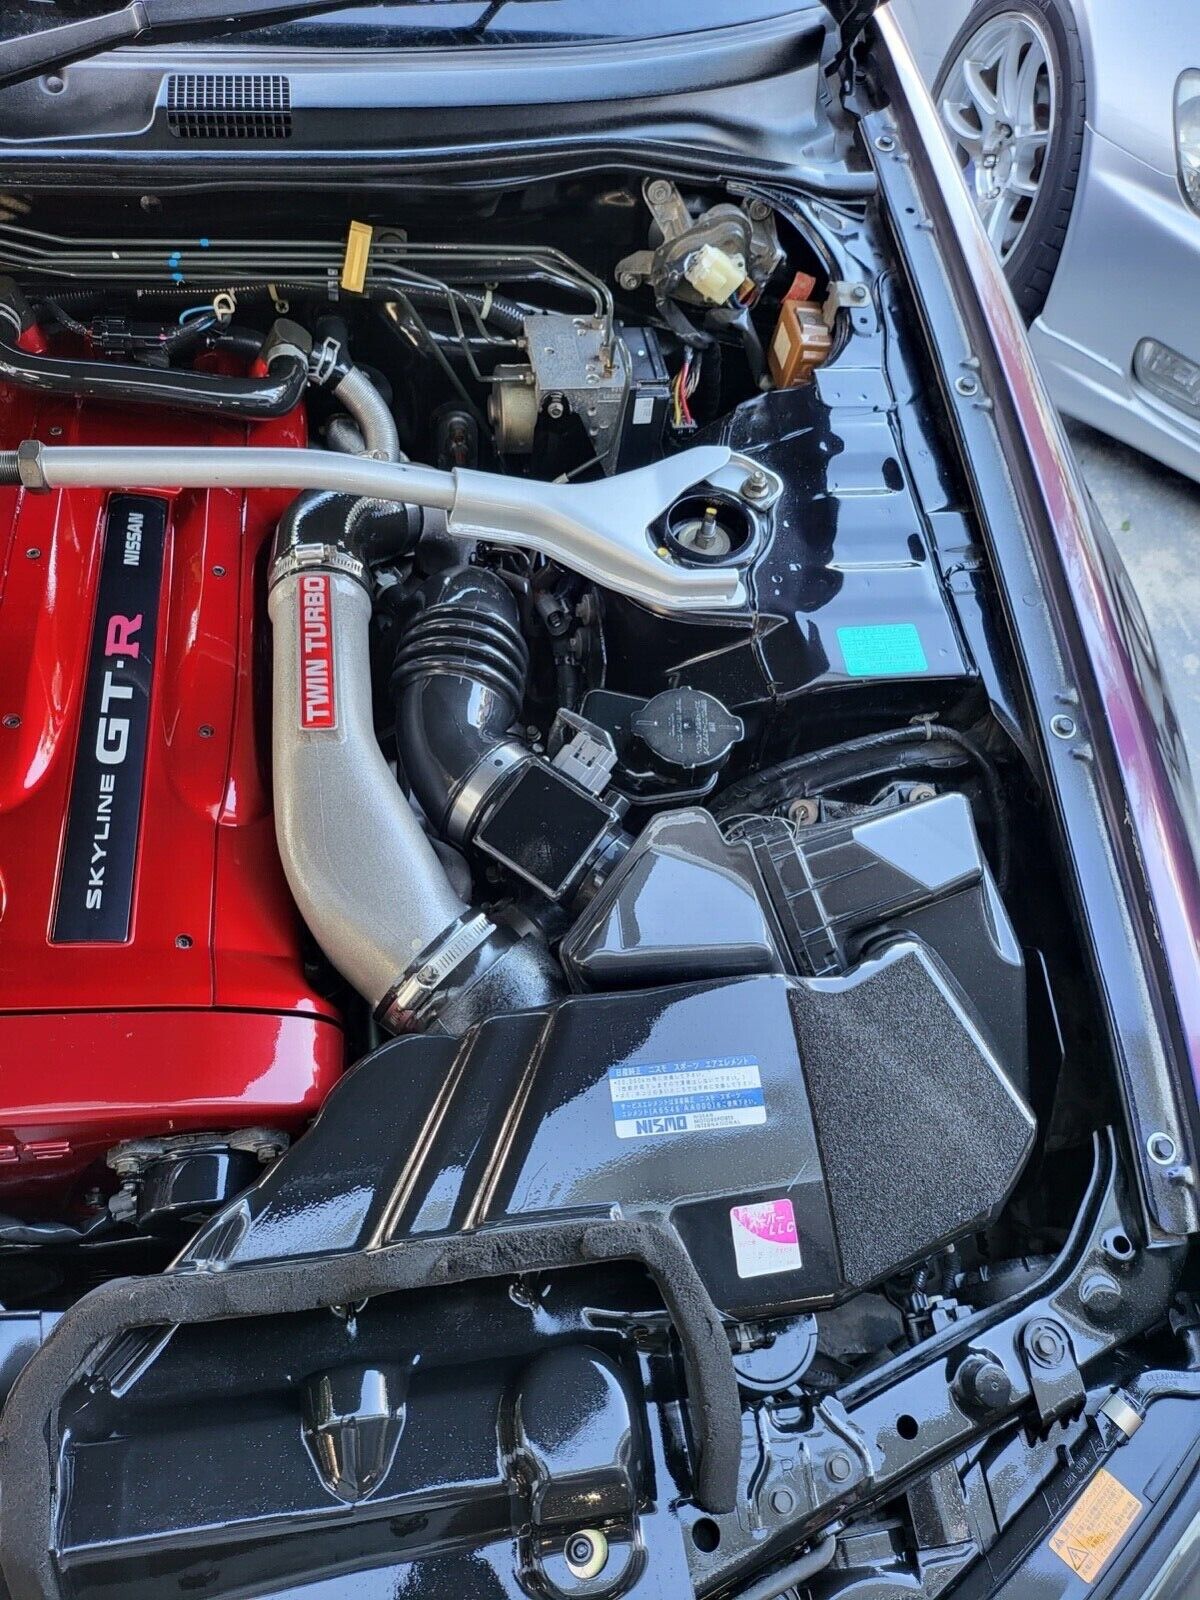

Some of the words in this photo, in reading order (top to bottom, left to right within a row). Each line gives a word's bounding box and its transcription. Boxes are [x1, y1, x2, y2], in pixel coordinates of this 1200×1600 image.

[123, 512, 144, 566] NISSAN
[303, 576, 328, 654] TURBO
[305, 659, 330, 722] TWIN
[85, 773, 116, 909] SKYLINE
[635, 1115, 688, 1135] NISMO
[768, 1221, 795, 1236] LLC
